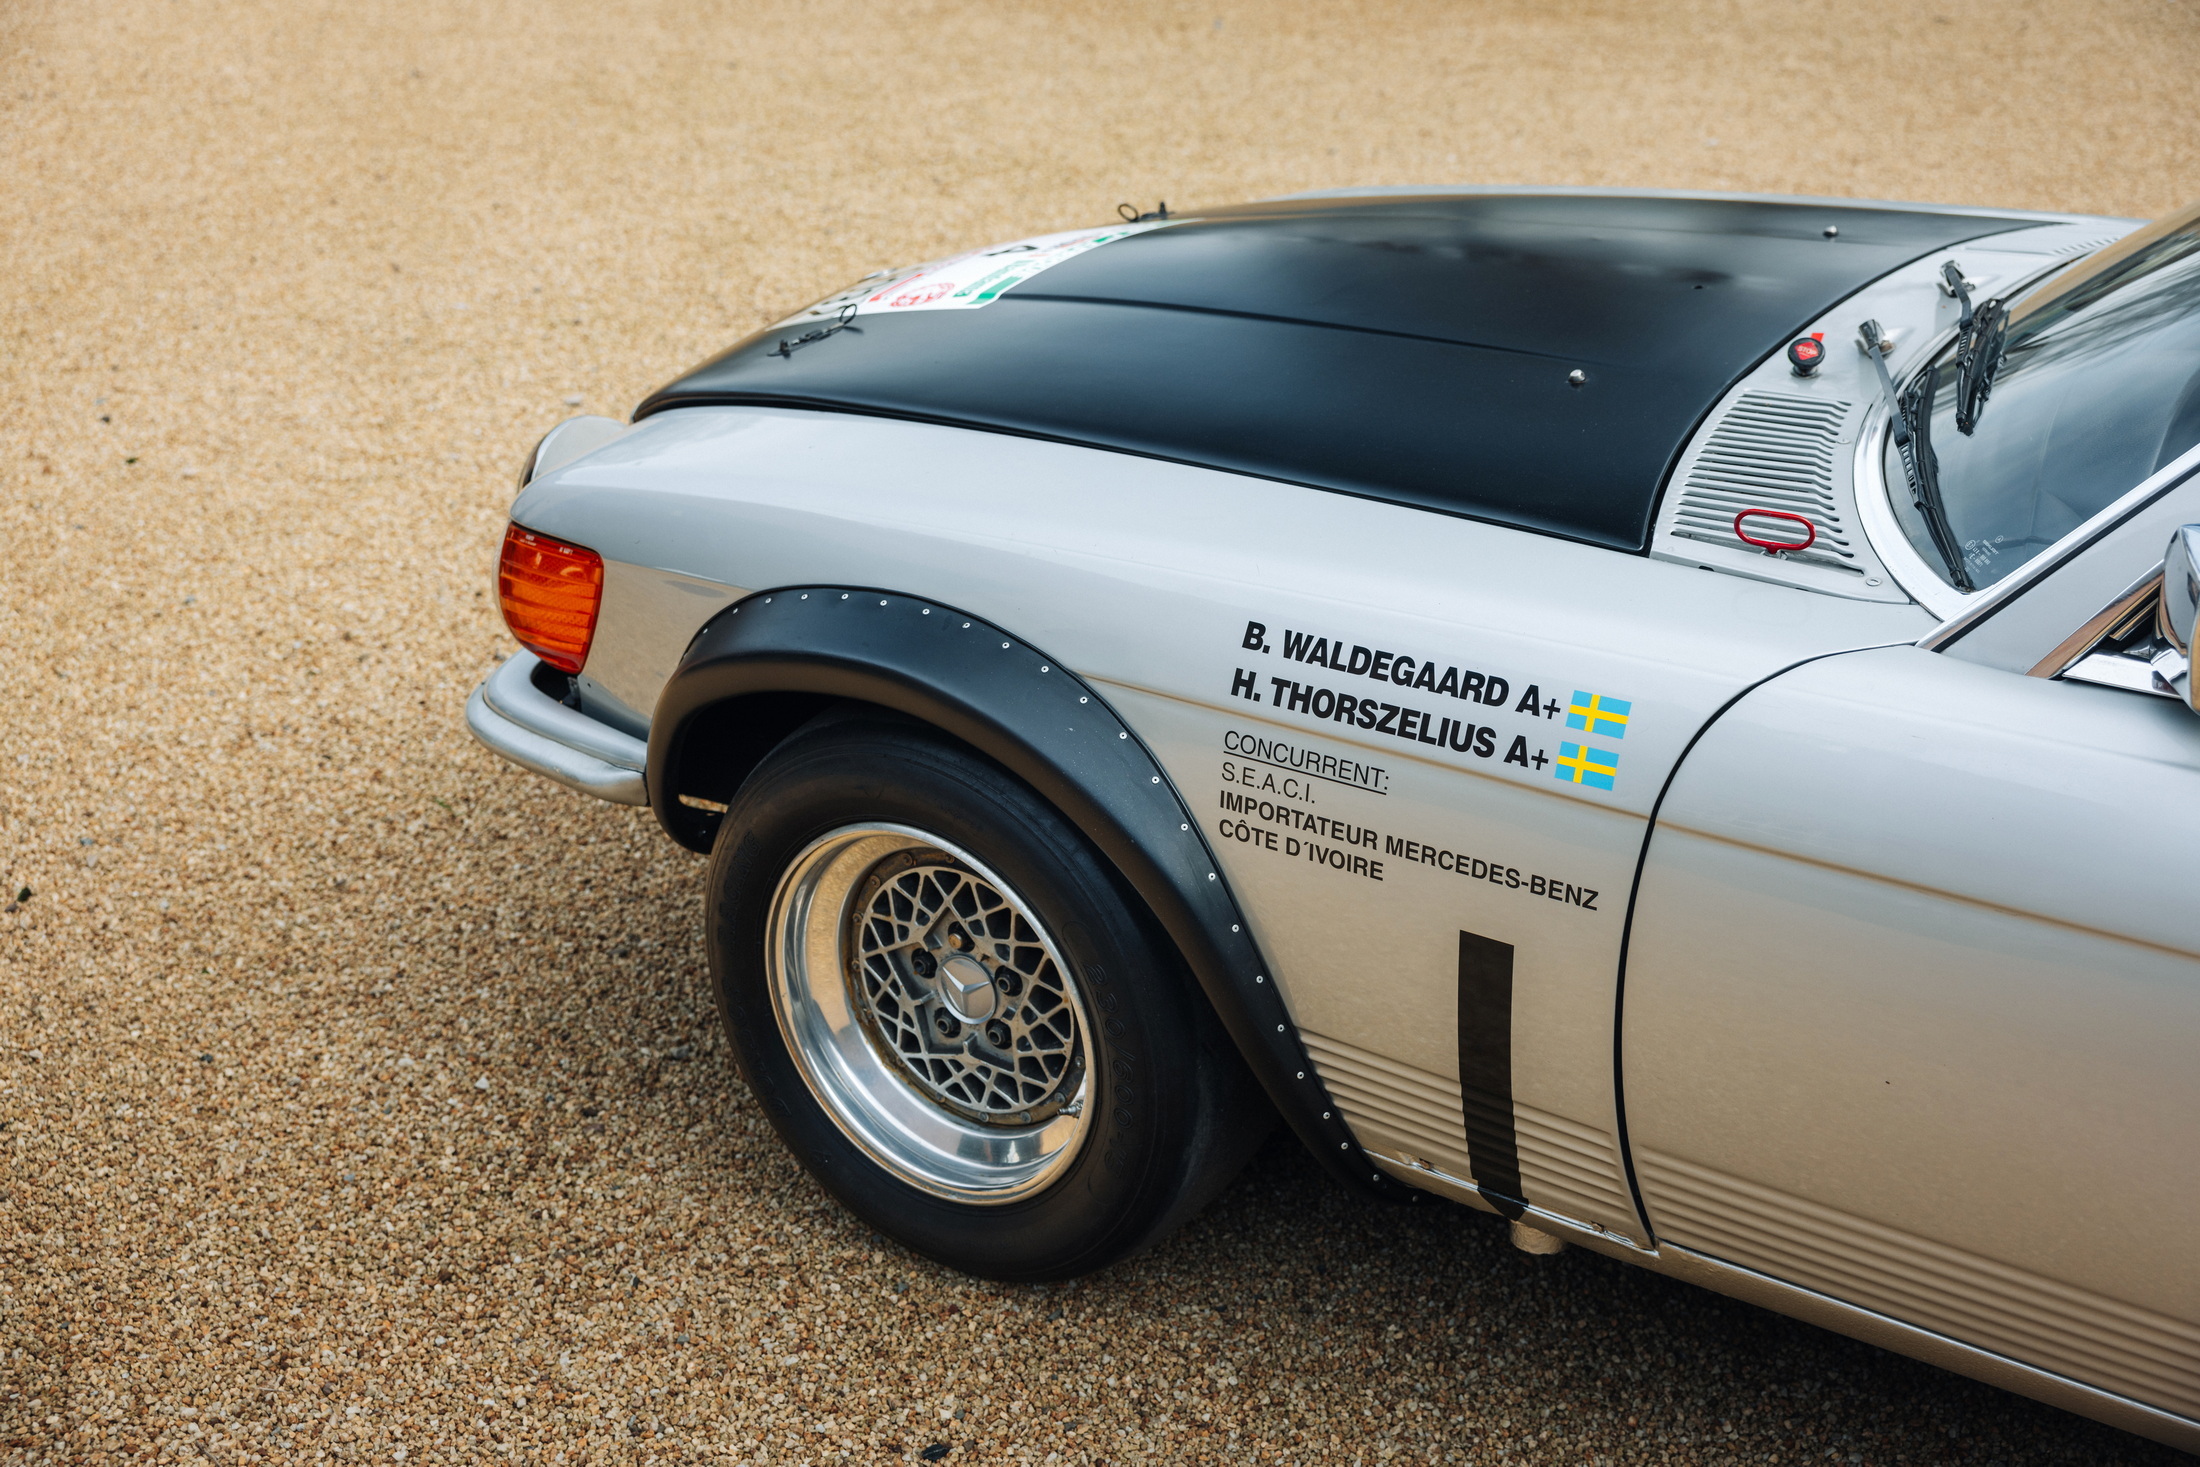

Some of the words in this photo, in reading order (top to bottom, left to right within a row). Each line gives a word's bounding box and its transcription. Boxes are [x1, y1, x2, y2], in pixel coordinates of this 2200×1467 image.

[1797, 345, 1818, 355] STOP
[1230, 667, 1261, 702] H.
[1271, 676, 1496, 758] THORSZELIUS
[1503, 735, 1548, 770] A+
[1242, 620, 1270, 654] B.
[1283, 629, 1509, 707] WALDEGAARD
[1515, 684, 1560, 719] A+
[1221, 761, 1315, 804] S.E.A.C.I.
[1224, 730, 1389, 791] CONCURRENT:
[1219, 819, 1278, 851] CÔTE
[1219, 790, 1378, 850] IMPORTATEUR
[1385, 835, 1599, 911] MERCEDES-BENZ
[717, 829, 763, 955] RACING
[1083, 962, 1135, 1179] 230/600-15
